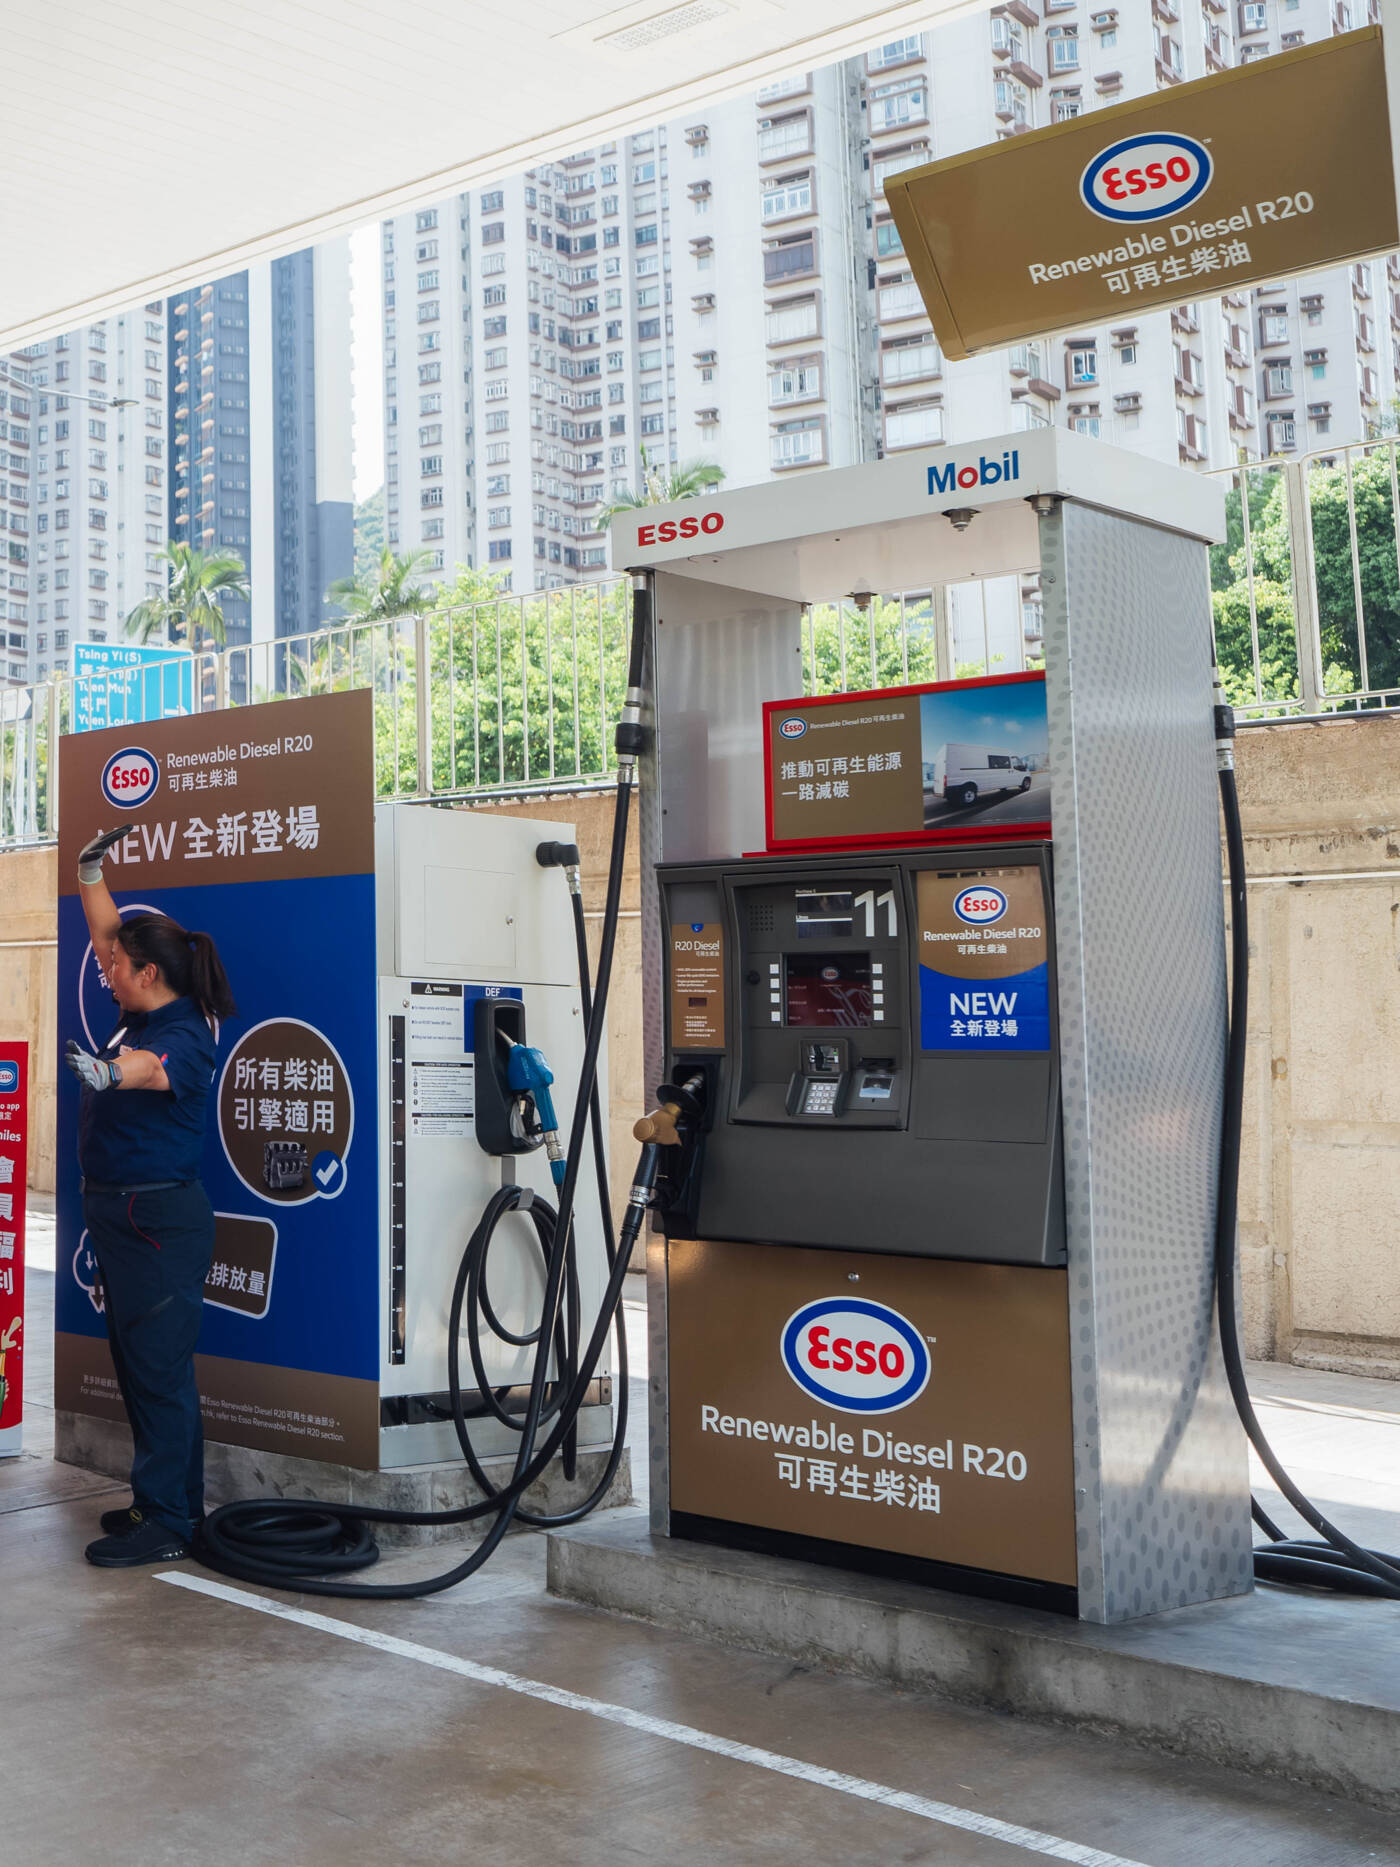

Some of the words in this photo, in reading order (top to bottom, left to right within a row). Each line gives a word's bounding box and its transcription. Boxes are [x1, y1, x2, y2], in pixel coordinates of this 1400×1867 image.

[1102, 155, 1191, 201] Esso
[1028, 235, 1167, 285] Renewable
[1170, 205, 1253, 247] Diesel
[1257, 190, 1315, 226] R20
[1101, 238, 1252, 295] 可再生柴油
[927, 450, 1020, 496] Mobil
[637, 511, 725, 547] ESSO
[78, 648, 108, 662] Tsing
[783, 723, 803, 733] Esso
[167, 745, 237, 769] Renewable
[240, 737, 281, 760] Diesel
[284, 734, 313, 753] R20
[781, 751, 902, 780] 推動可再生能源
[111, 766, 150, 790] Esso
[168, 767, 238, 792] 可再生柴油
[782, 780, 850, 801] 一路減碳
[182, 805, 321, 860] 全新登場
[854, 890, 897, 937] 11
[963, 897, 999, 912] Esso
[675, 941, 693, 951] R20
[694, 940, 720, 951] Diesel
[923, 929, 981, 942] Renewable
[984, 928, 1016, 939] Diesel
[1018, 928, 1041, 938] R20
[957, 944, 1007, 955] 可再生柴油
[485, 987, 500, 997] DEF
[950, 992, 1018, 1016] NEW
[950, 1019, 1018, 1037] 全新登場
[234, 1057, 334, 1092] 所有柴油
[234, 1098, 334, 1134] 引擎適用
[205, 1261, 266, 1296] 排放量
[807, 1325, 904, 1379] Esso
[701, 1404, 854, 1454] Renewable
[862, 1429, 954, 1471] Diesel
[962, 1442, 1028, 1481] R20
[775, 1451, 942, 1515] 可再生柴油
